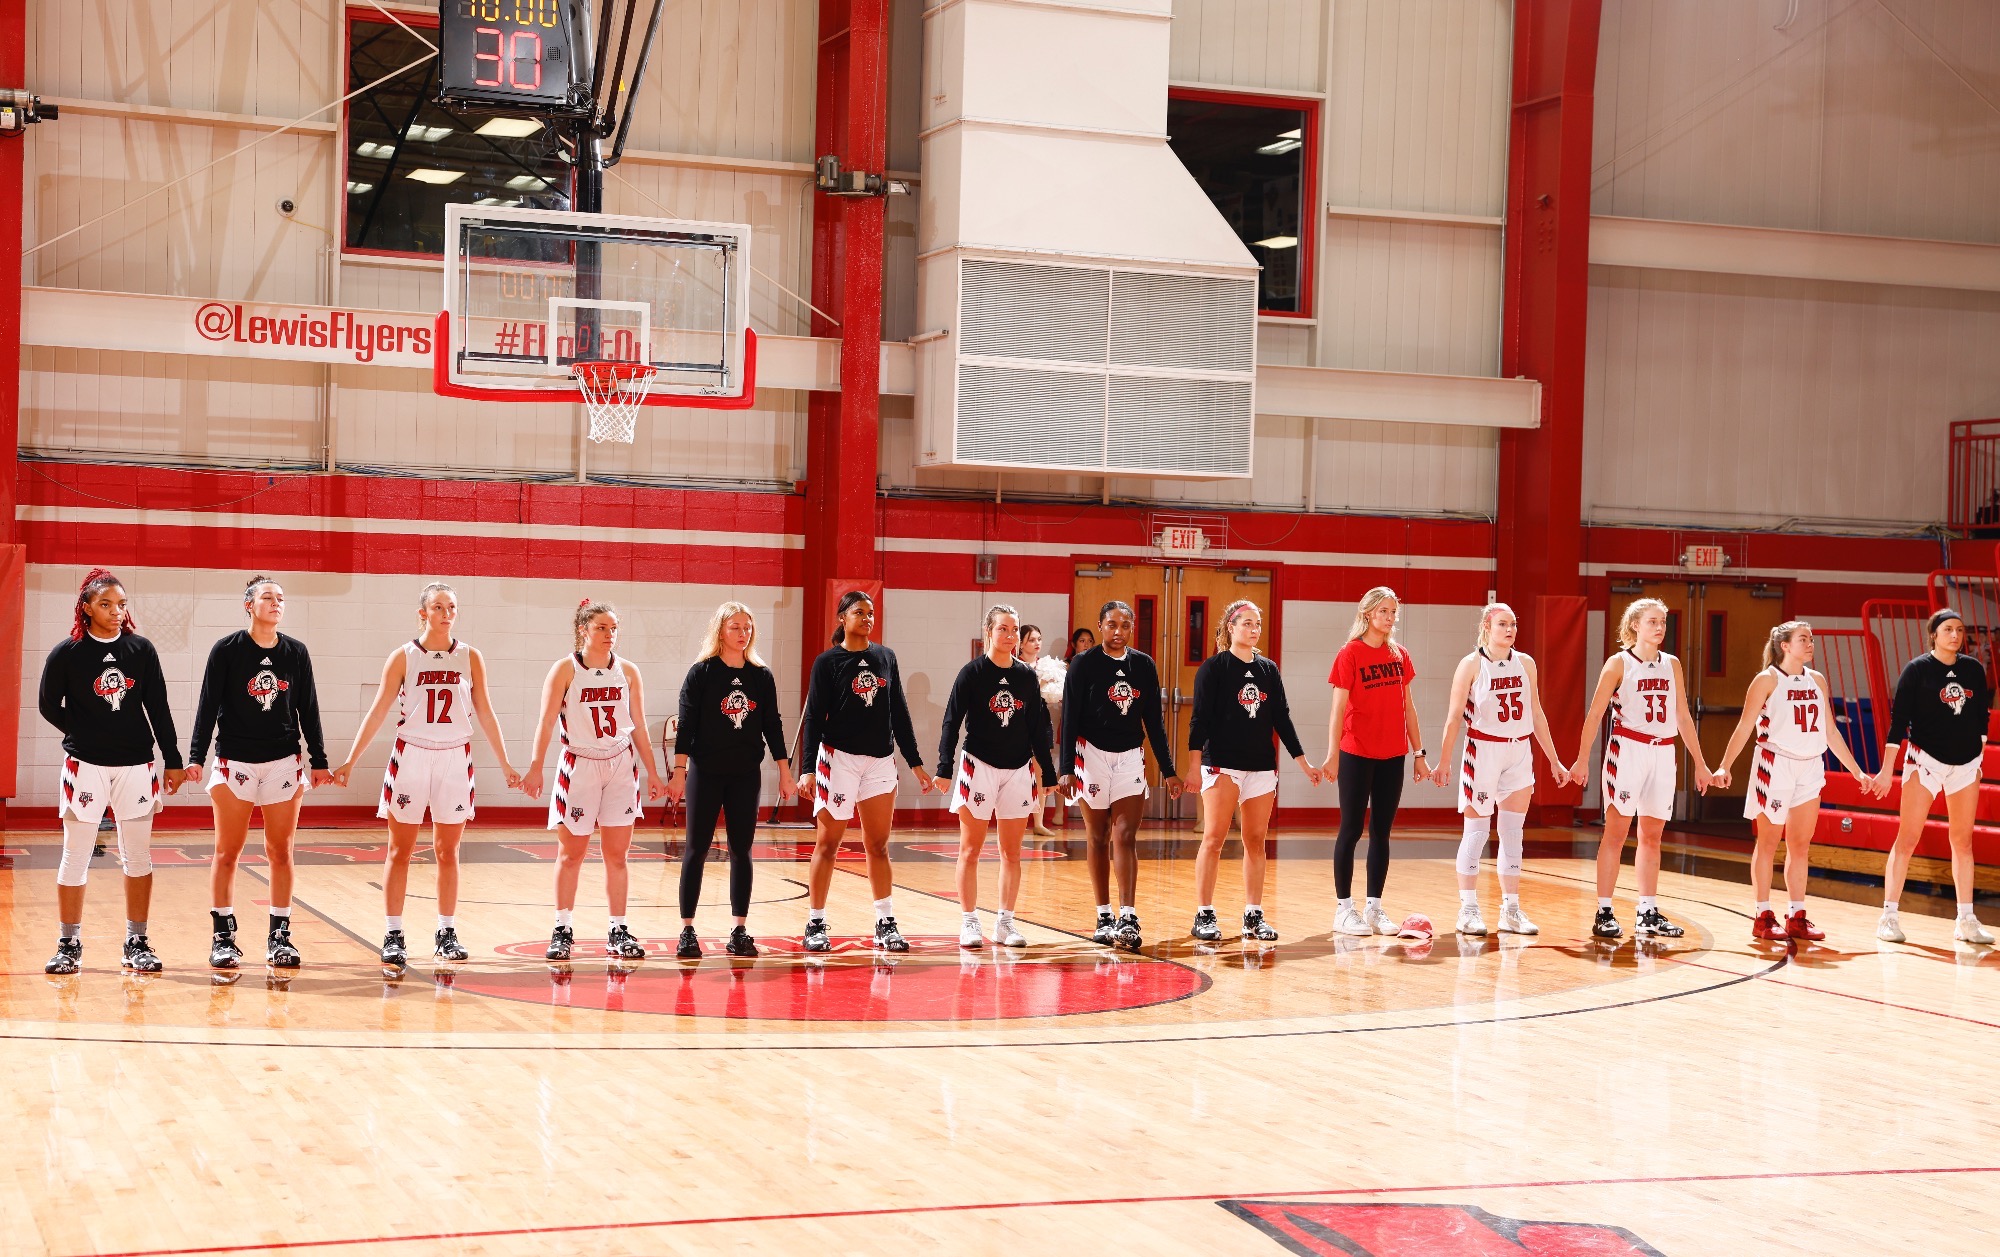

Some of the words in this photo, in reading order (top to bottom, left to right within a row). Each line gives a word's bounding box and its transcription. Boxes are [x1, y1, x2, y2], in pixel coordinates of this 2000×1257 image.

[475, 27, 541, 90] 30
[195, 302, 432, 363] @LewisFlyers
[1172, 529, 1197, 549] EXIT
[1696, 547, 1718, 567] EXIT
[416, 670, 462, 687] FLYERS
[1489, 675, 1523, 692] FLYERS
[1636, 678, 1670, 692] FLYERS
[426, 688, 453, 724] 12
[579, 686, 623, 703] FLYERS
[1495, 691, 1524, 723] 35
[1786, 689, 1819, 701] FLYERS
[1643, 694, 1668, 724] 33
[1793, 703, 1819, 733] 42
[589, 705, 617, 739] 13
